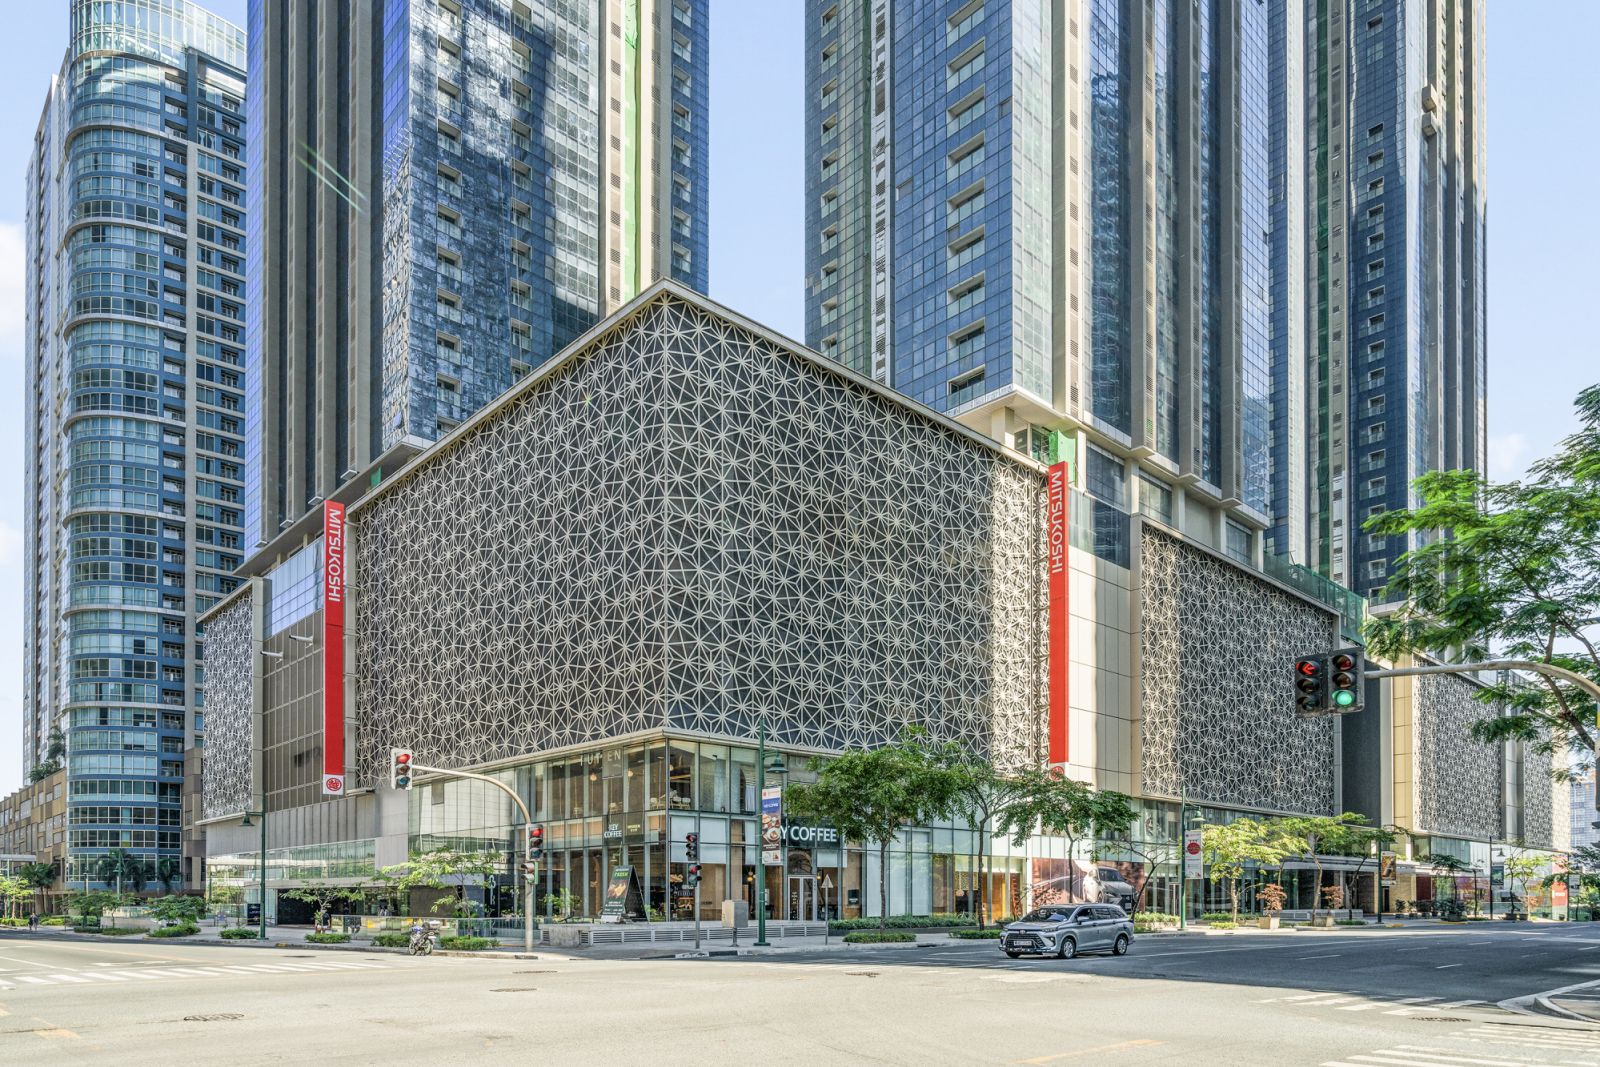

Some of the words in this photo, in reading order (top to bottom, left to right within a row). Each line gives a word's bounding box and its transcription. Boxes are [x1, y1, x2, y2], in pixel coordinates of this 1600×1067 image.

[328, 508, 341, 602] MITSUKOSHI
[1051, 470, 1063, 574] MITSUKOSHI
[790, 825, 838, 842] COFFEE
